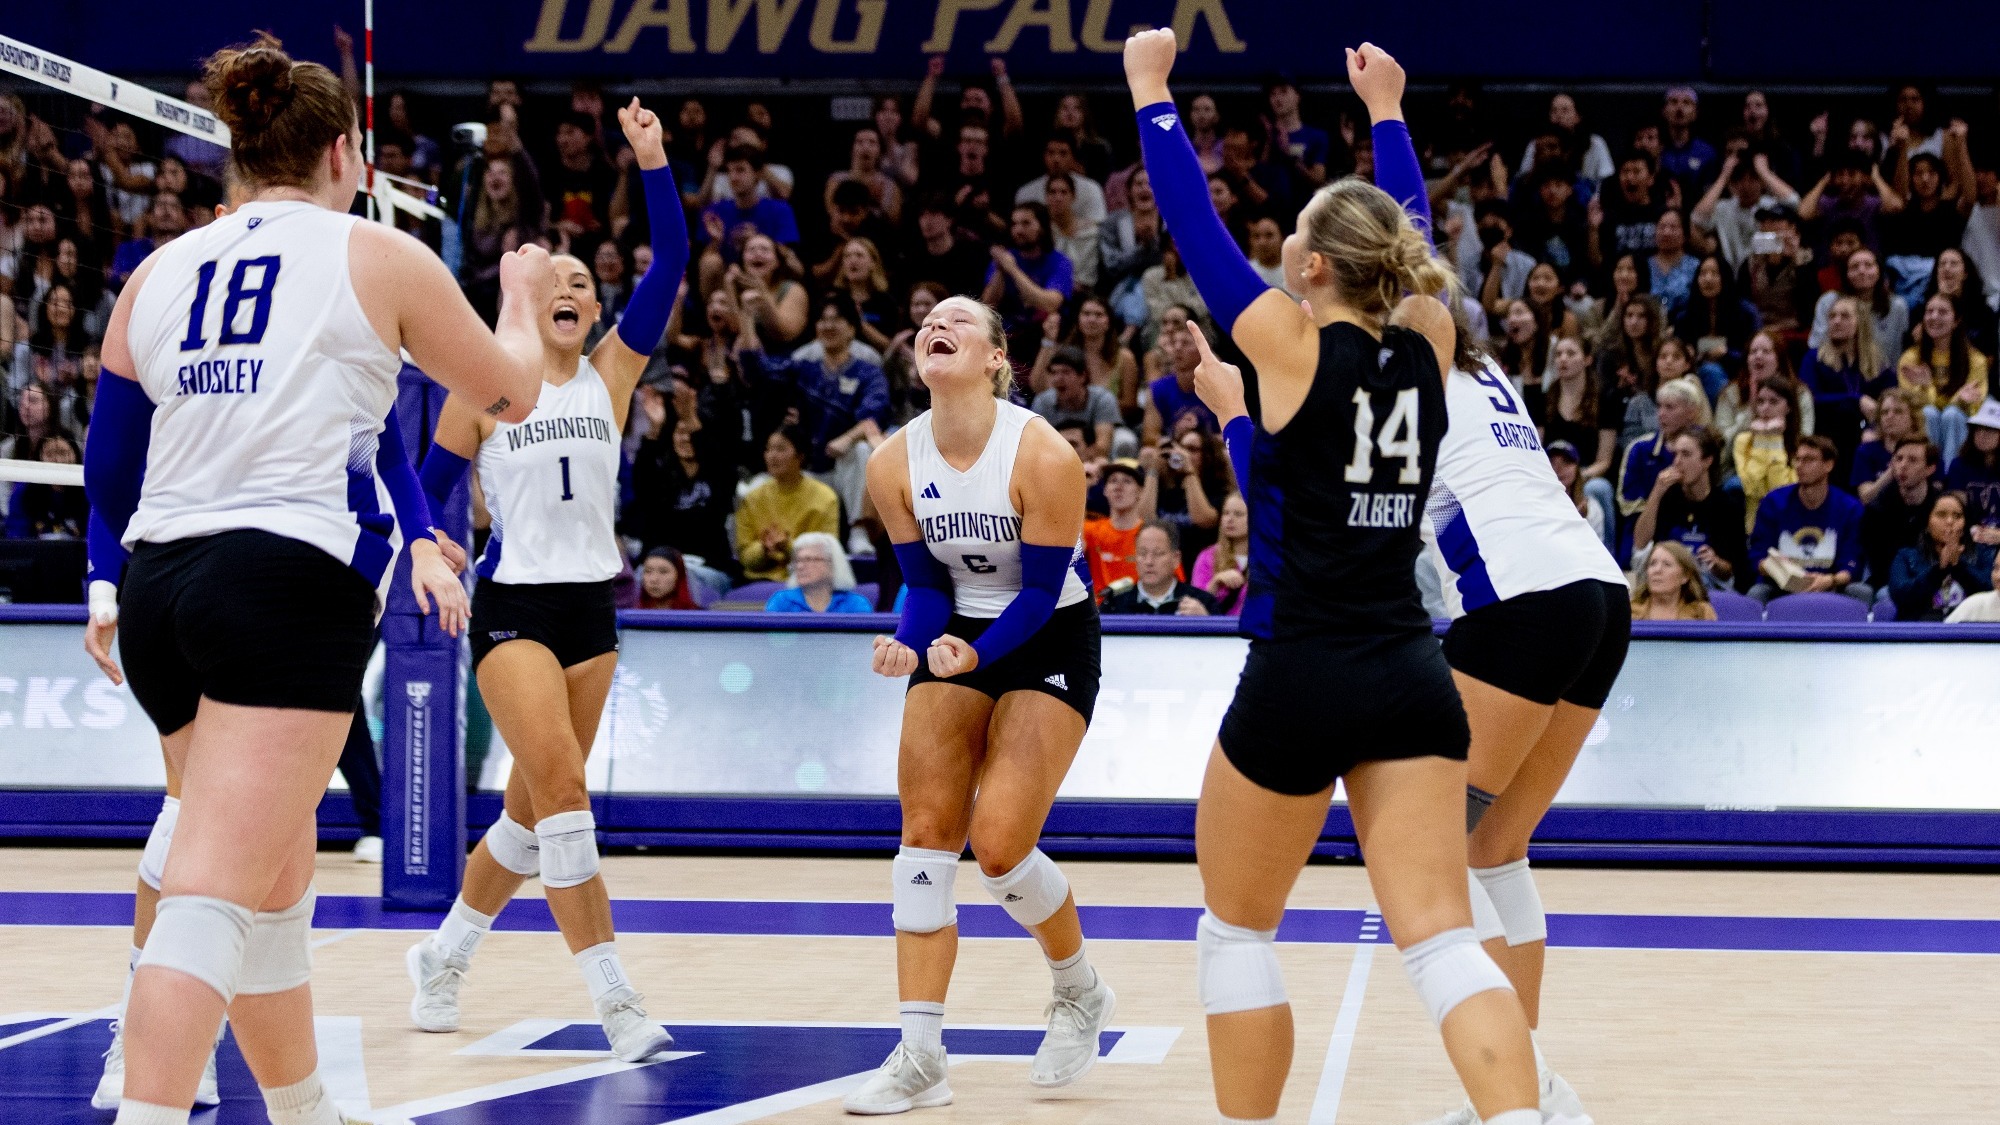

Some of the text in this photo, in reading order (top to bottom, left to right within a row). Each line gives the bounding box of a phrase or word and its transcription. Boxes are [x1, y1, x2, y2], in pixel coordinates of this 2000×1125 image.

[179, 254, 281, 353] 18
[506, 416, 611, 452] WASHINGTON
[1344, 386, 1421, 485] 14
[559, 456, 574, 501] 1
[1347, 491, 1417, 529] ZILBERT
